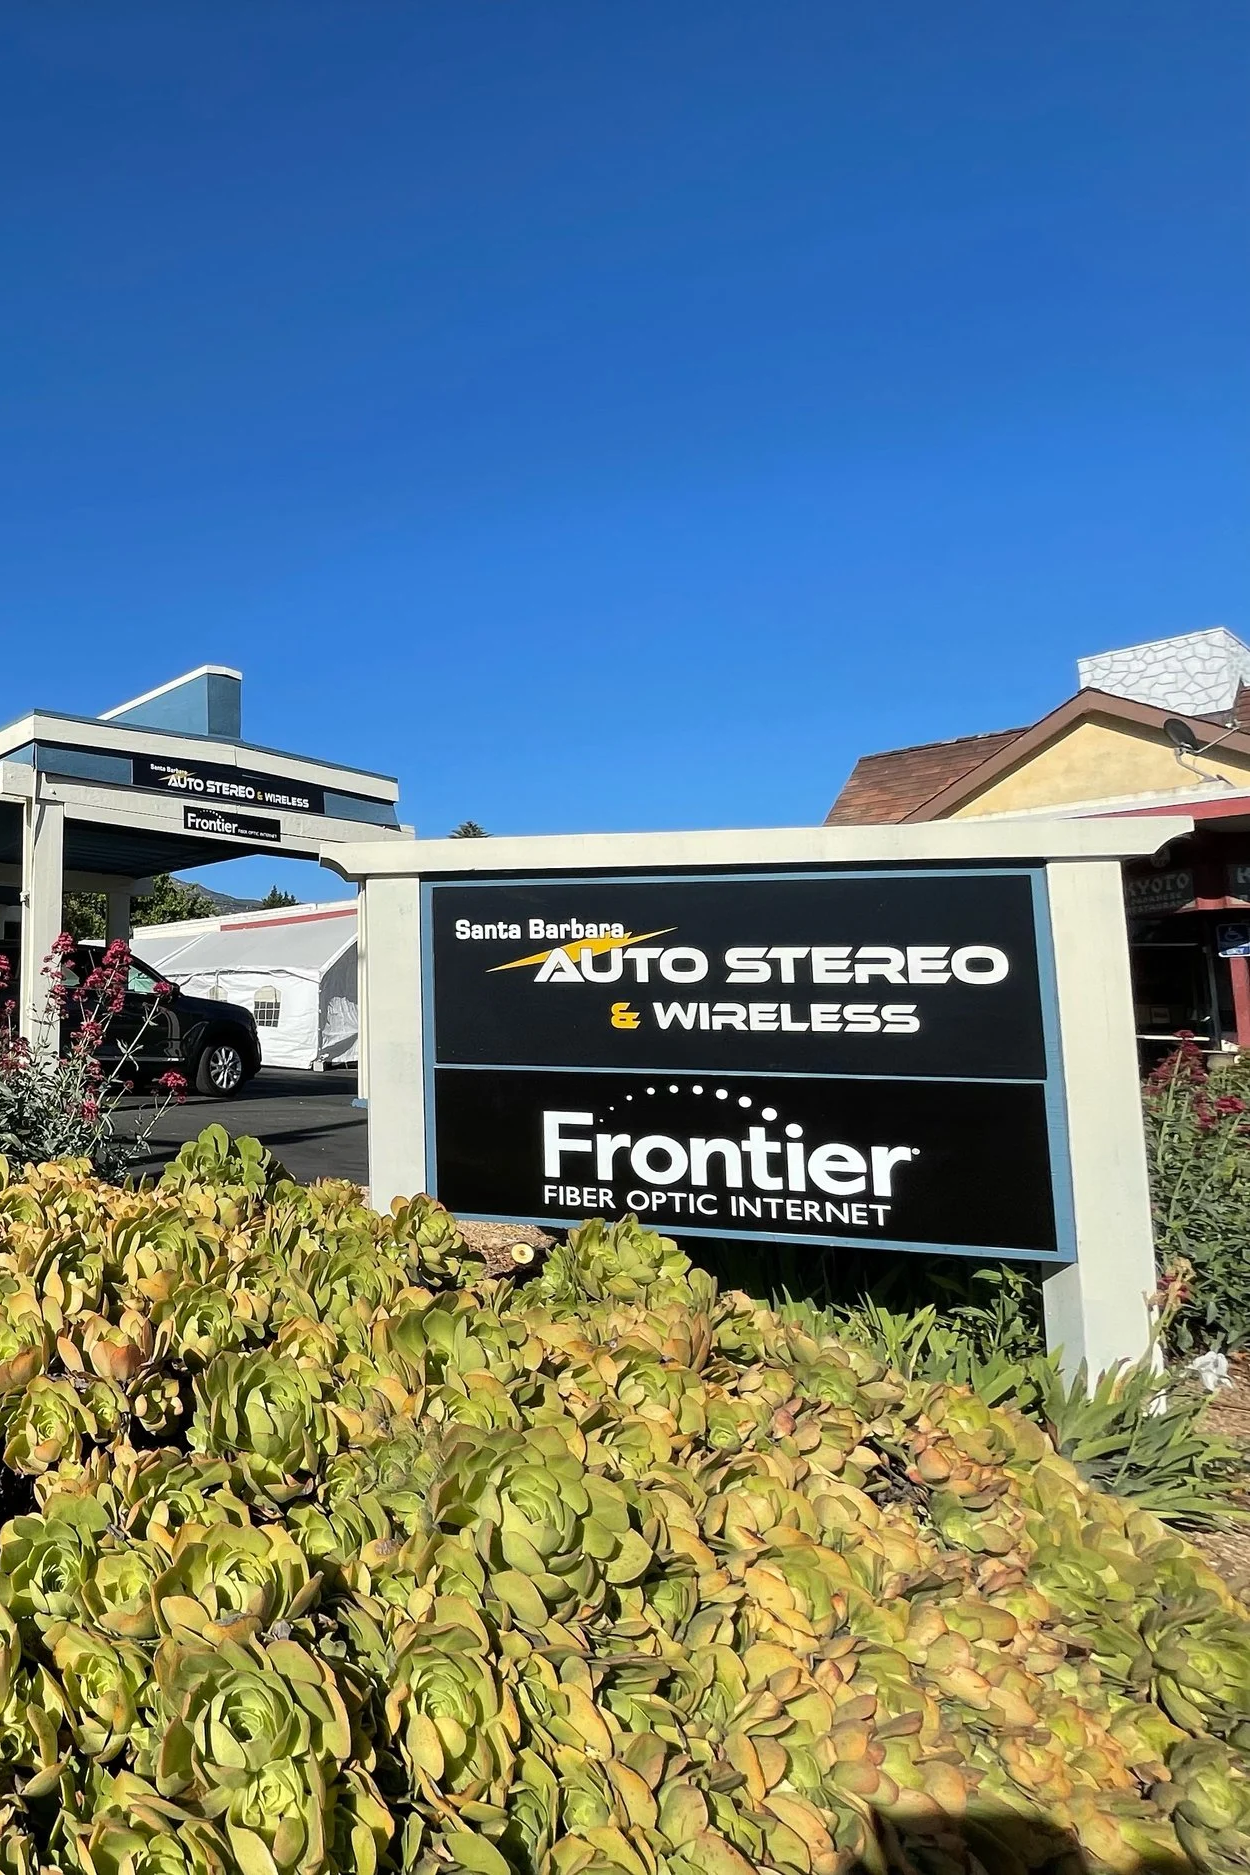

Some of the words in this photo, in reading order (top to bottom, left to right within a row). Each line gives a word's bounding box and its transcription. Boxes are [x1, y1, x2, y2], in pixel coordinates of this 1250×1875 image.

[167, 775, 204, 792] AUTO
[206, 780, 255, 799] STEREO
[256, 791, 264, 801] &
[264, 792, 310, 809] WIRELESS
[187, 813, 238, 834] Frontier
[455, 919, 522, 941] Santa
[528, 918, 624, 940] Barbara
[534, 946, 709, 984] AUTO
[724, 944, 1010, 985] STEREO
[611, 1003, 641, 1030] &
[653, 1002, 921, 1034] WIRELESS
[542, 1110, 913, 1197] Frontier
[543, 1184, 616, 1210] FIBER
[626, 1189, 719, 1217] OPTIC
[731, 1196, 892, 1227] INTERNET
